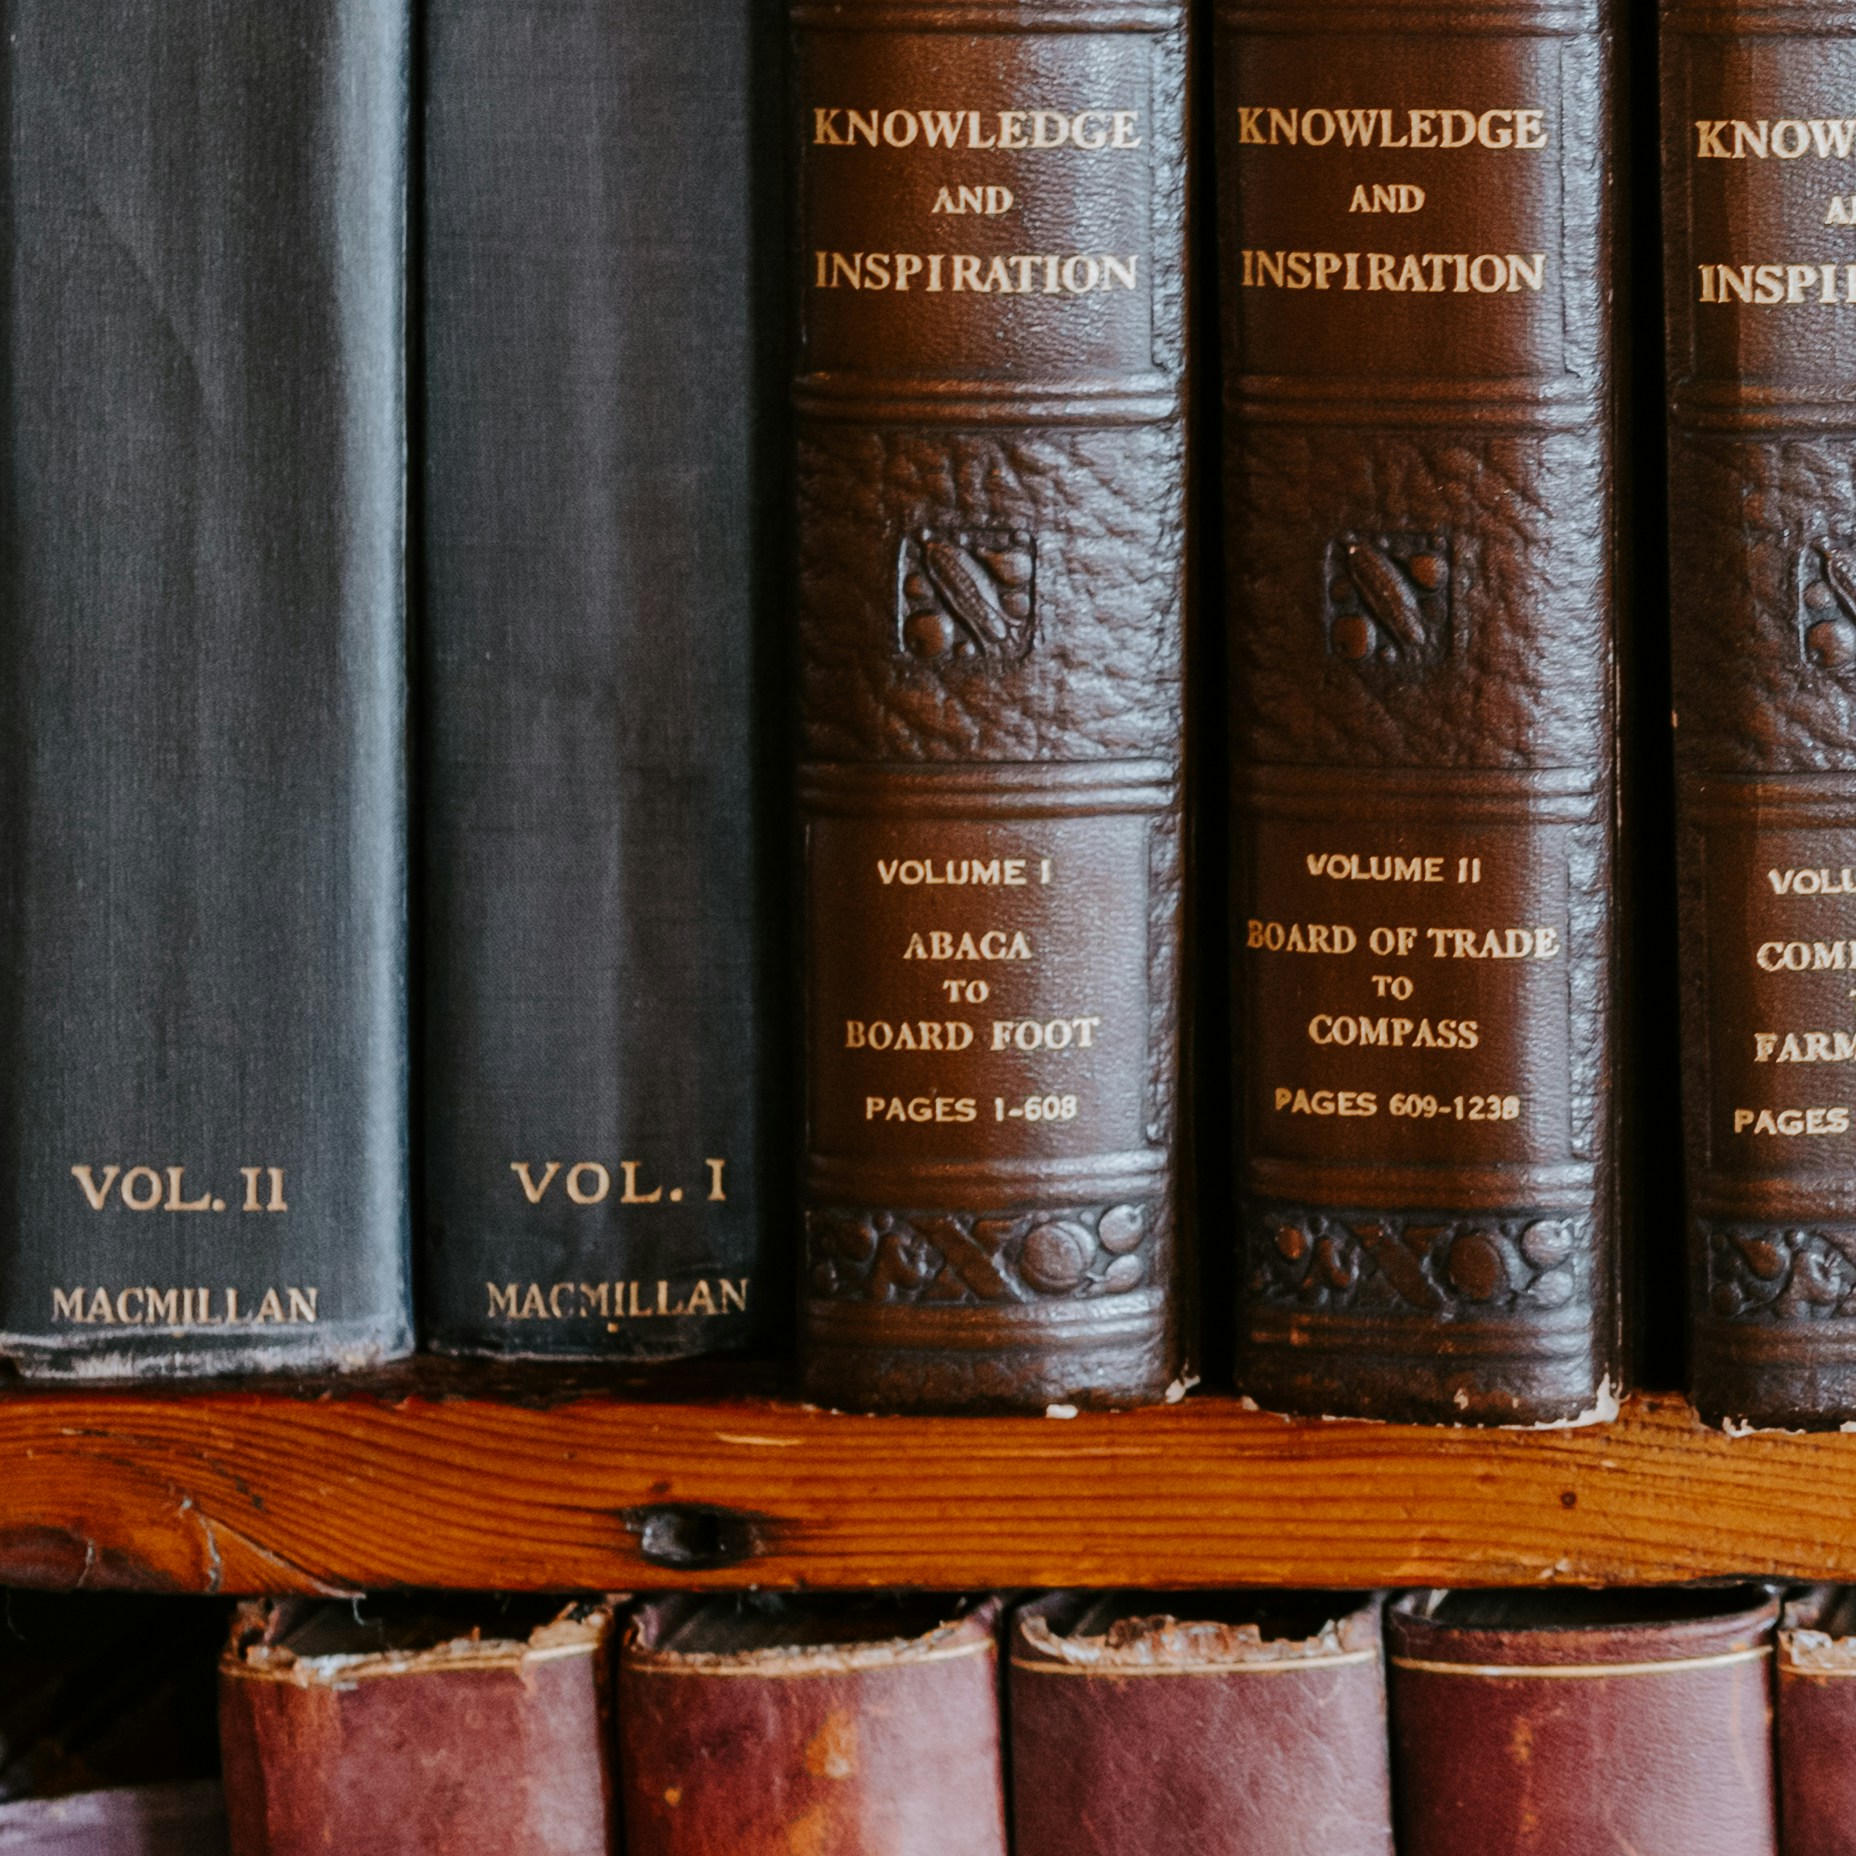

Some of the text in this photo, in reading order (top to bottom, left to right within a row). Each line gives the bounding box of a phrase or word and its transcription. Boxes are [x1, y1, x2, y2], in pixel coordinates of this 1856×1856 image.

[812, 108, 1143, 149] KNOWLEDGE
[1238, 108, 1548, 149] KNOWLEDGE
[815, 252, 1138, 294] INSPIRATION
[1242, 249, 1546, 293] INSPIRATION
[878, 859, 1050, 886] VOLUME I
[1307, 853, 1483, 884] VOLUME II
[903, 932, 1033, 961] ABACA
[1247, 921, 1560, 959] BOARD OF TRADE
[845, 1017, 1100, 1050] BOARD FOOT
[1308, 1015, 1479, 1049] COMPASS
[865, 1095, 1078, 1122] PAGES 1-608
[1275, 1088, 1378, 1117] PAGES
[1733, 1108, 1850, 1135] PAGES
[72, 1164, 288, 1212] VOL. II
[511, 1158, 726, 1204] VOL. I
[51, 1286, 319, 1324] MACMILLAN
[486, 1278, 749, 1319] MACMILLAN
